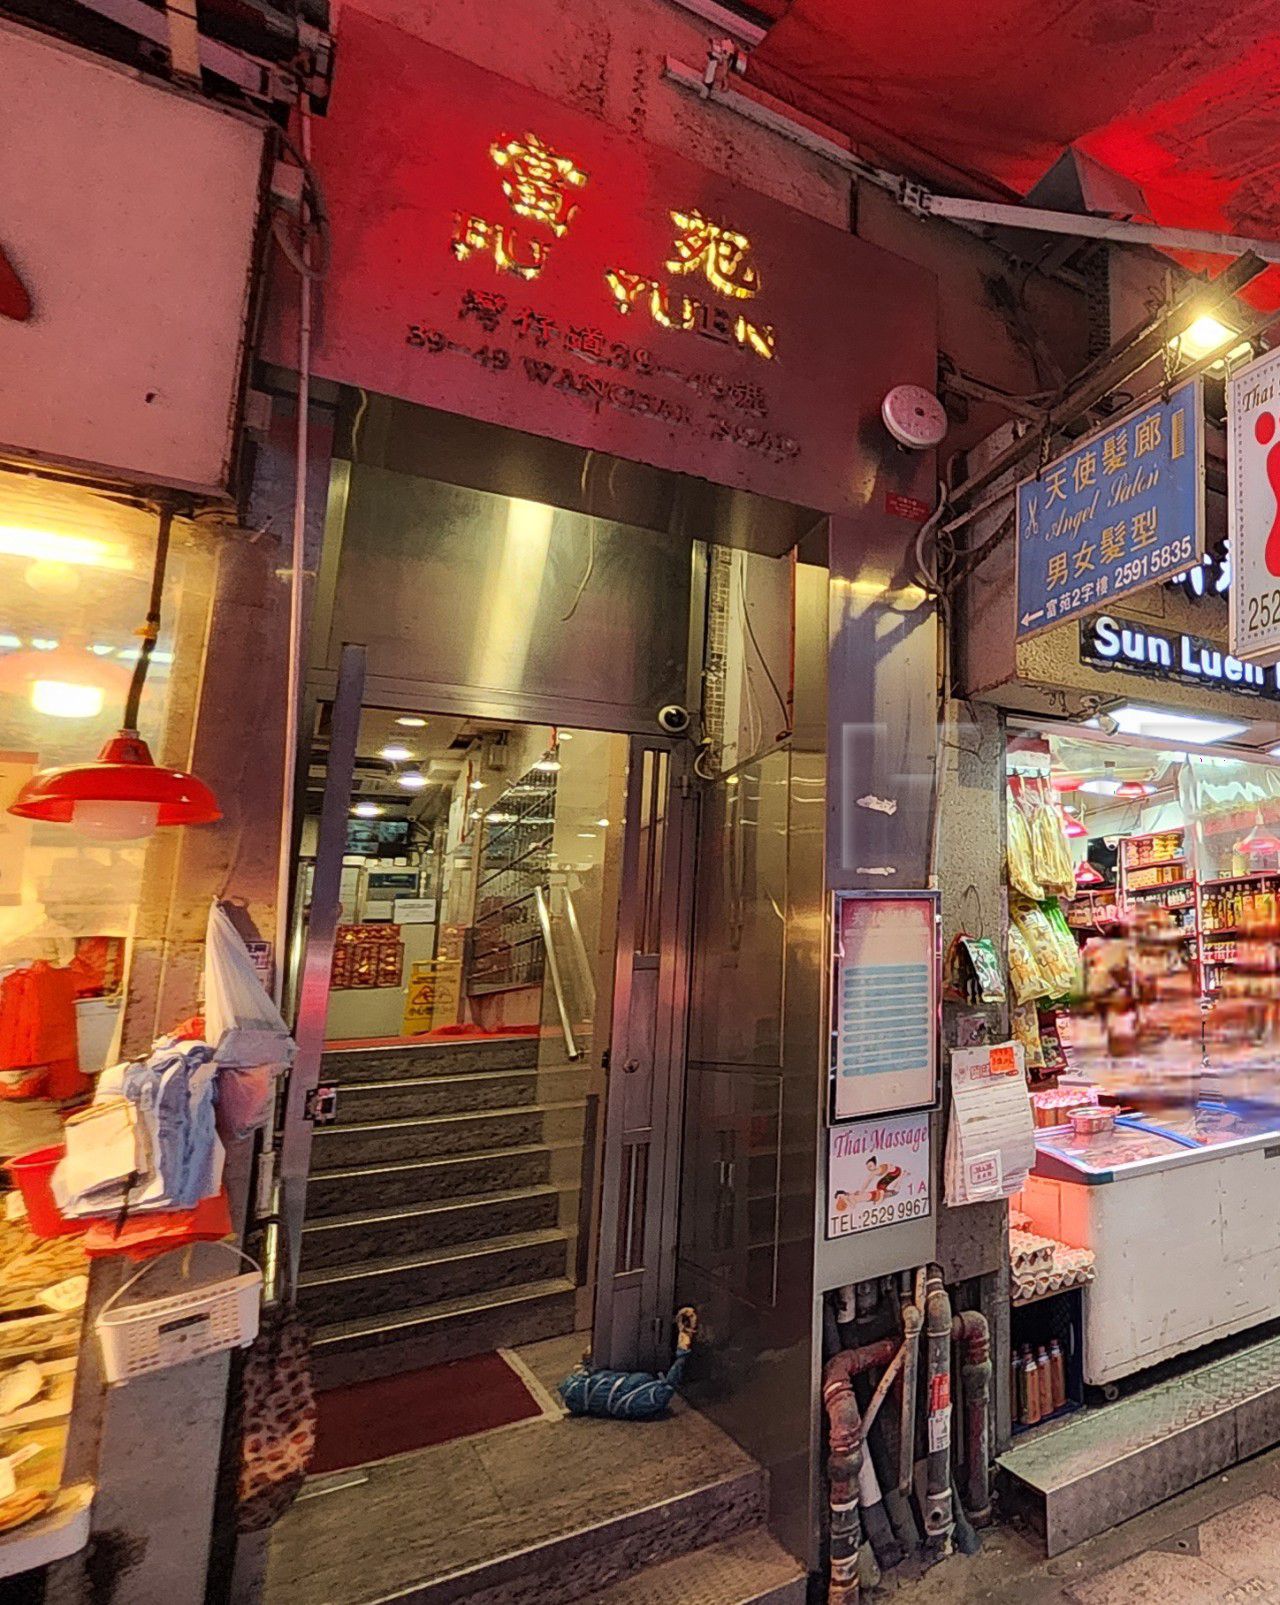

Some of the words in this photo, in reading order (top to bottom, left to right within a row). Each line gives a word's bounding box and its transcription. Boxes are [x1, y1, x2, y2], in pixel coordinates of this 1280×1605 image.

[451, 210, 551, 280] FU
[604, 267, 778, 362] YUEN
[1241, 378, 1275, 413] Thai
[1045, 412, 1162, 510] 天使髮廊
[1045, 489, 1100, 542] Angel
[1046, 506, 1158, 592] 男女髮型
[1094, 616, 1171, 667] Sun
[1181, 635, 1264, 685] Luen
[834, 1130, 866, 1158] Thai
[870, 1126, 928, 1152] Massage
[898, 1197, 928, 1217] 9967
